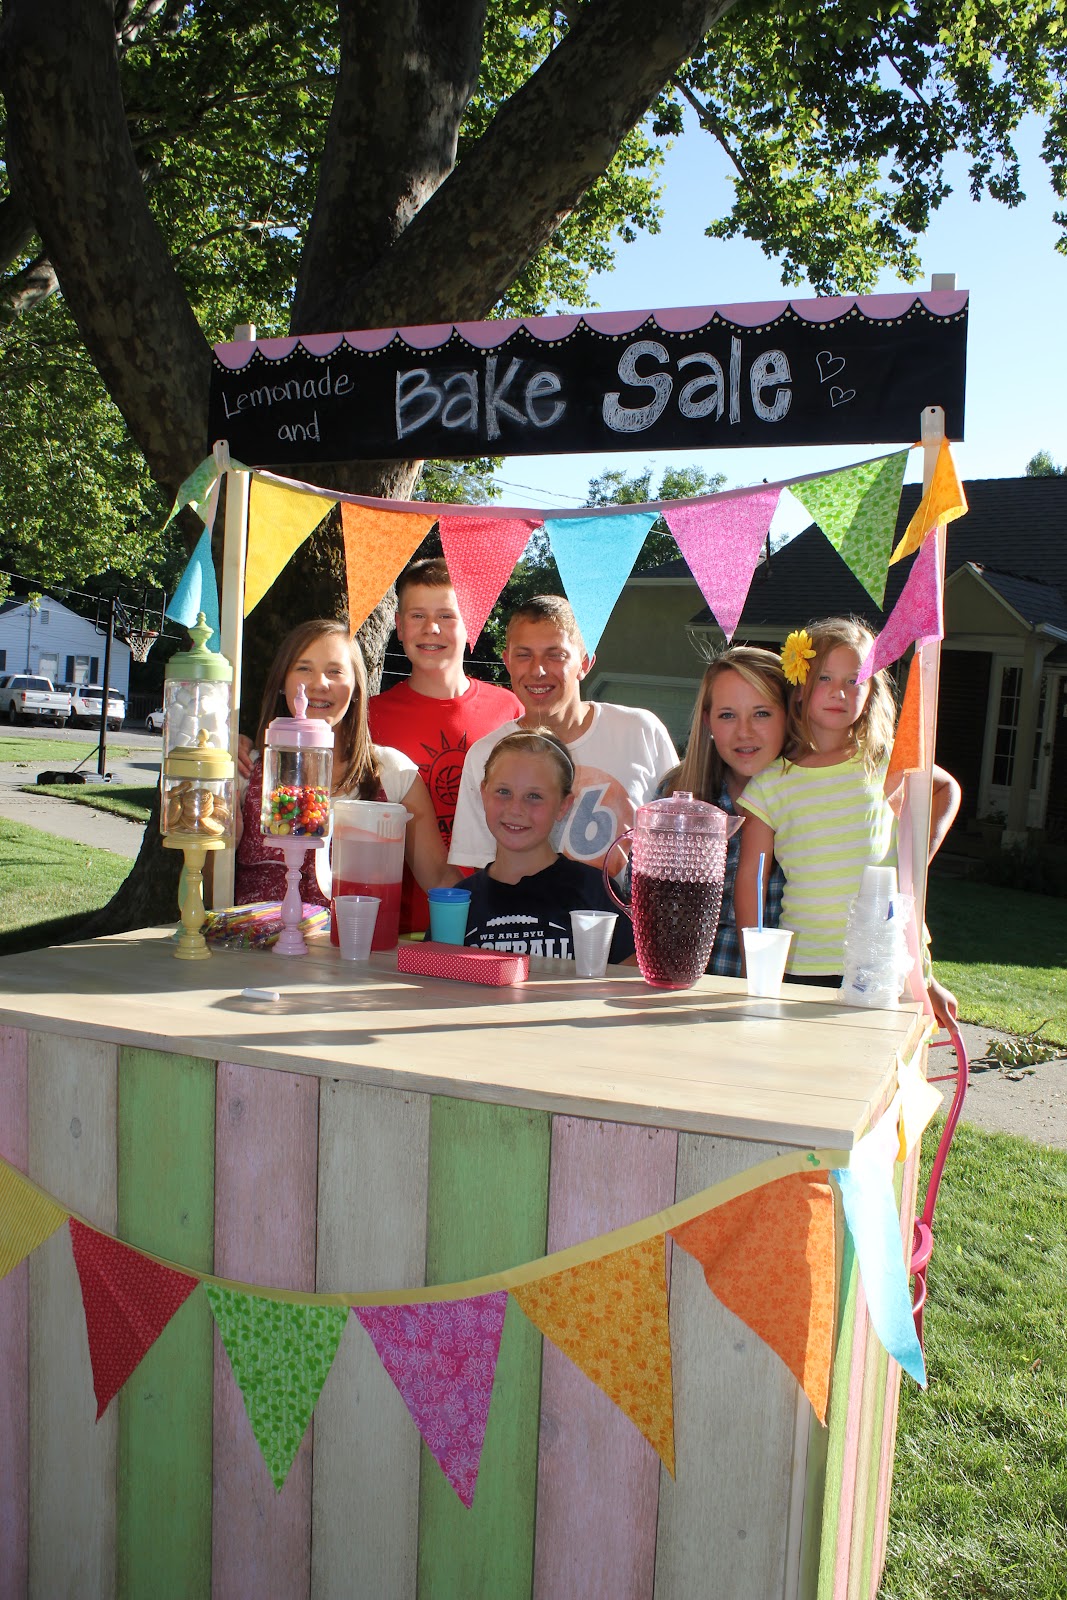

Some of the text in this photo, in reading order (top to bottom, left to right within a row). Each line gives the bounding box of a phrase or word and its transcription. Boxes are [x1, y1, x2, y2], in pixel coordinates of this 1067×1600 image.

[222, 366, 355, 420] Lemonade
[602, 335, 793, 433] Sale
[277, 410, 321, 442] and
[523, 930, 545, 938] BYU
